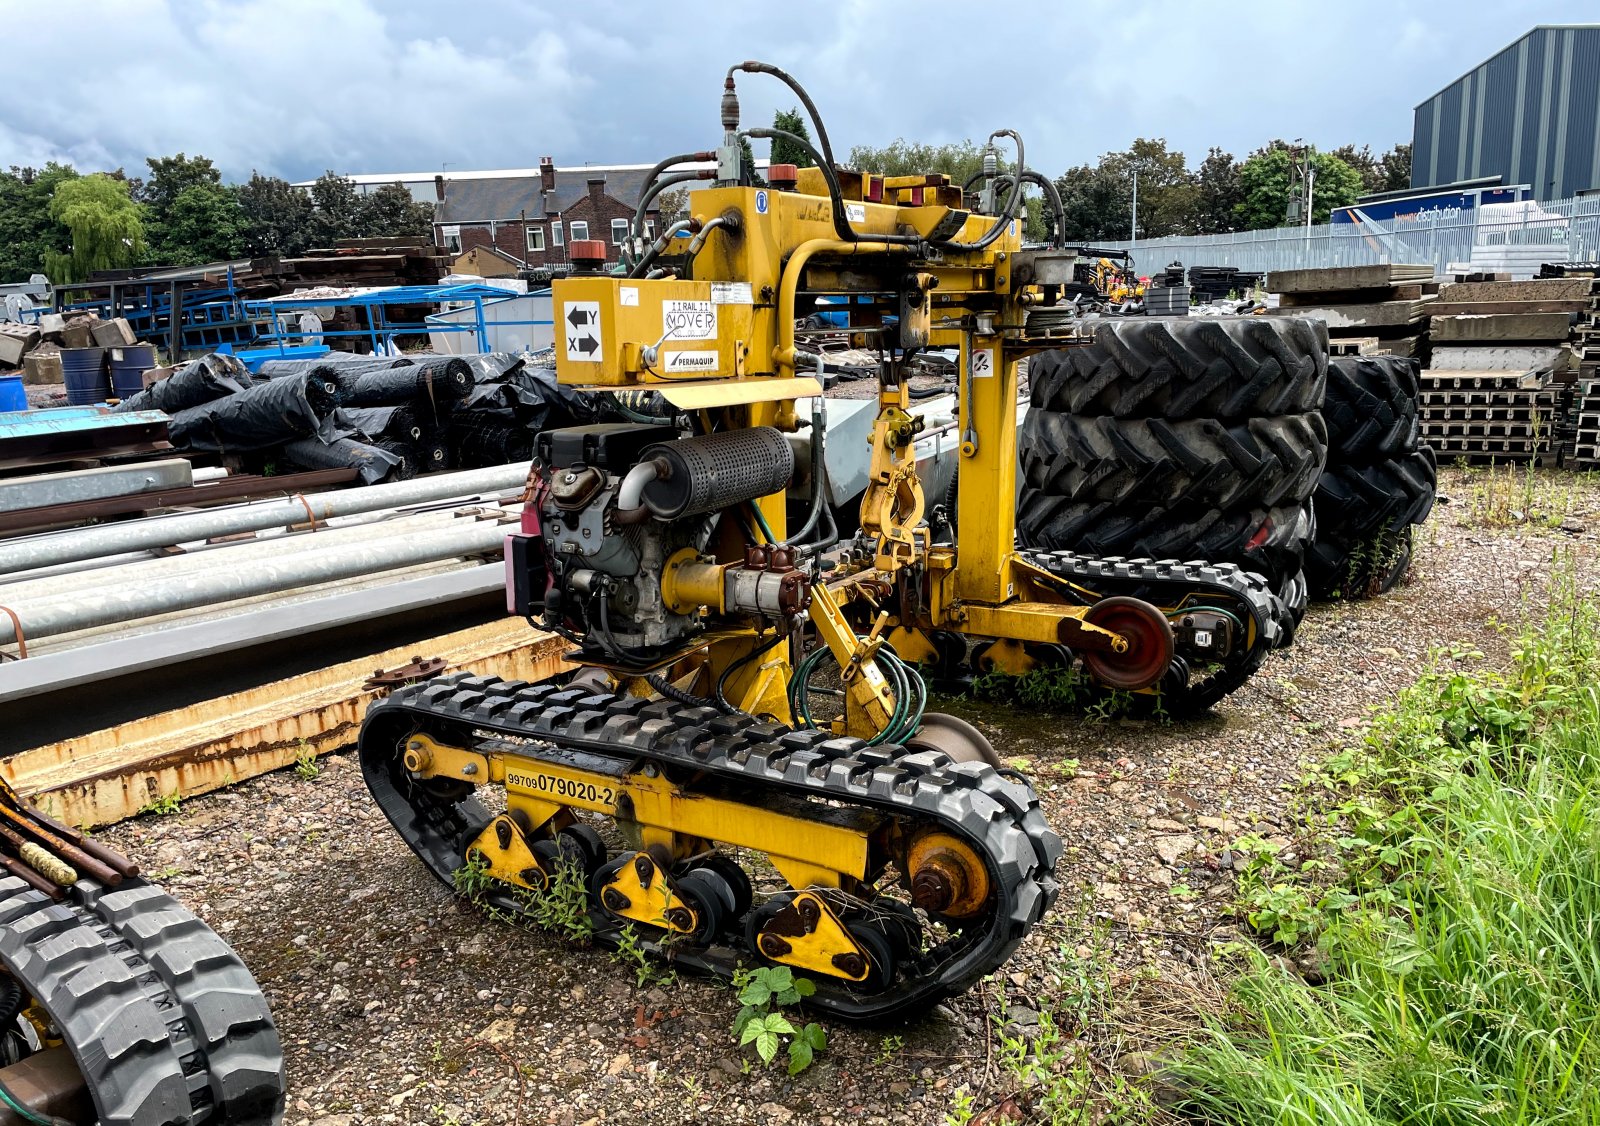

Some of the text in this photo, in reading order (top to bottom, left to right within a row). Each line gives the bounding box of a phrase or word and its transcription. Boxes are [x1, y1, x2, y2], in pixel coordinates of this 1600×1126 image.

[683, 302, 697, 311] RAIL
[588, 310, 598, 325] Y
[667, 313, 714, 329] MOVER
[568, 337, 578, 352] X
[678, 357, 714, 366] PERMAQUIP
